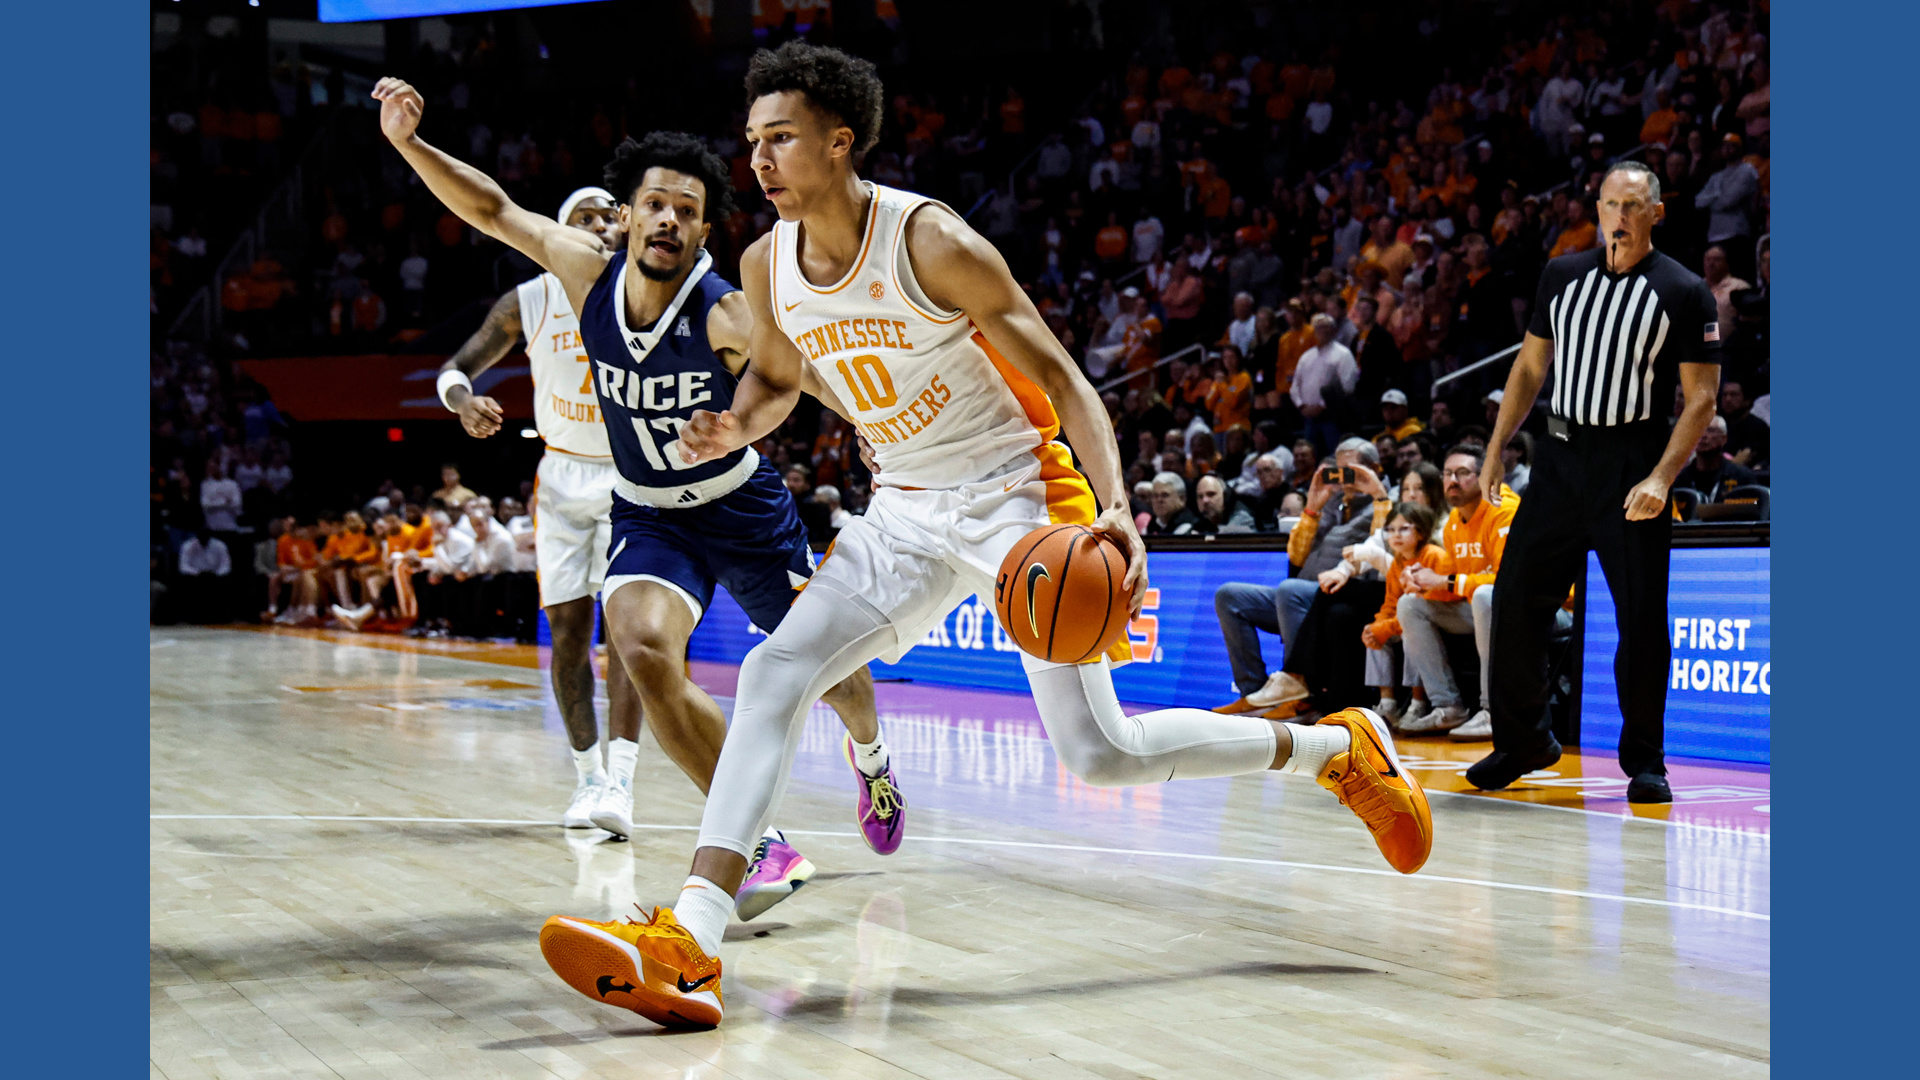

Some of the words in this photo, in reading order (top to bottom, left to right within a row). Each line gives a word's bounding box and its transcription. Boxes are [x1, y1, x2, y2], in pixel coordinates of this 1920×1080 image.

[795, 318, 914, 362] TENNESSEE
[595, 359, 712, 411] RICE
[836, 354, 898, 412] 10
[1673, 618, 1750, 651] FIRST
